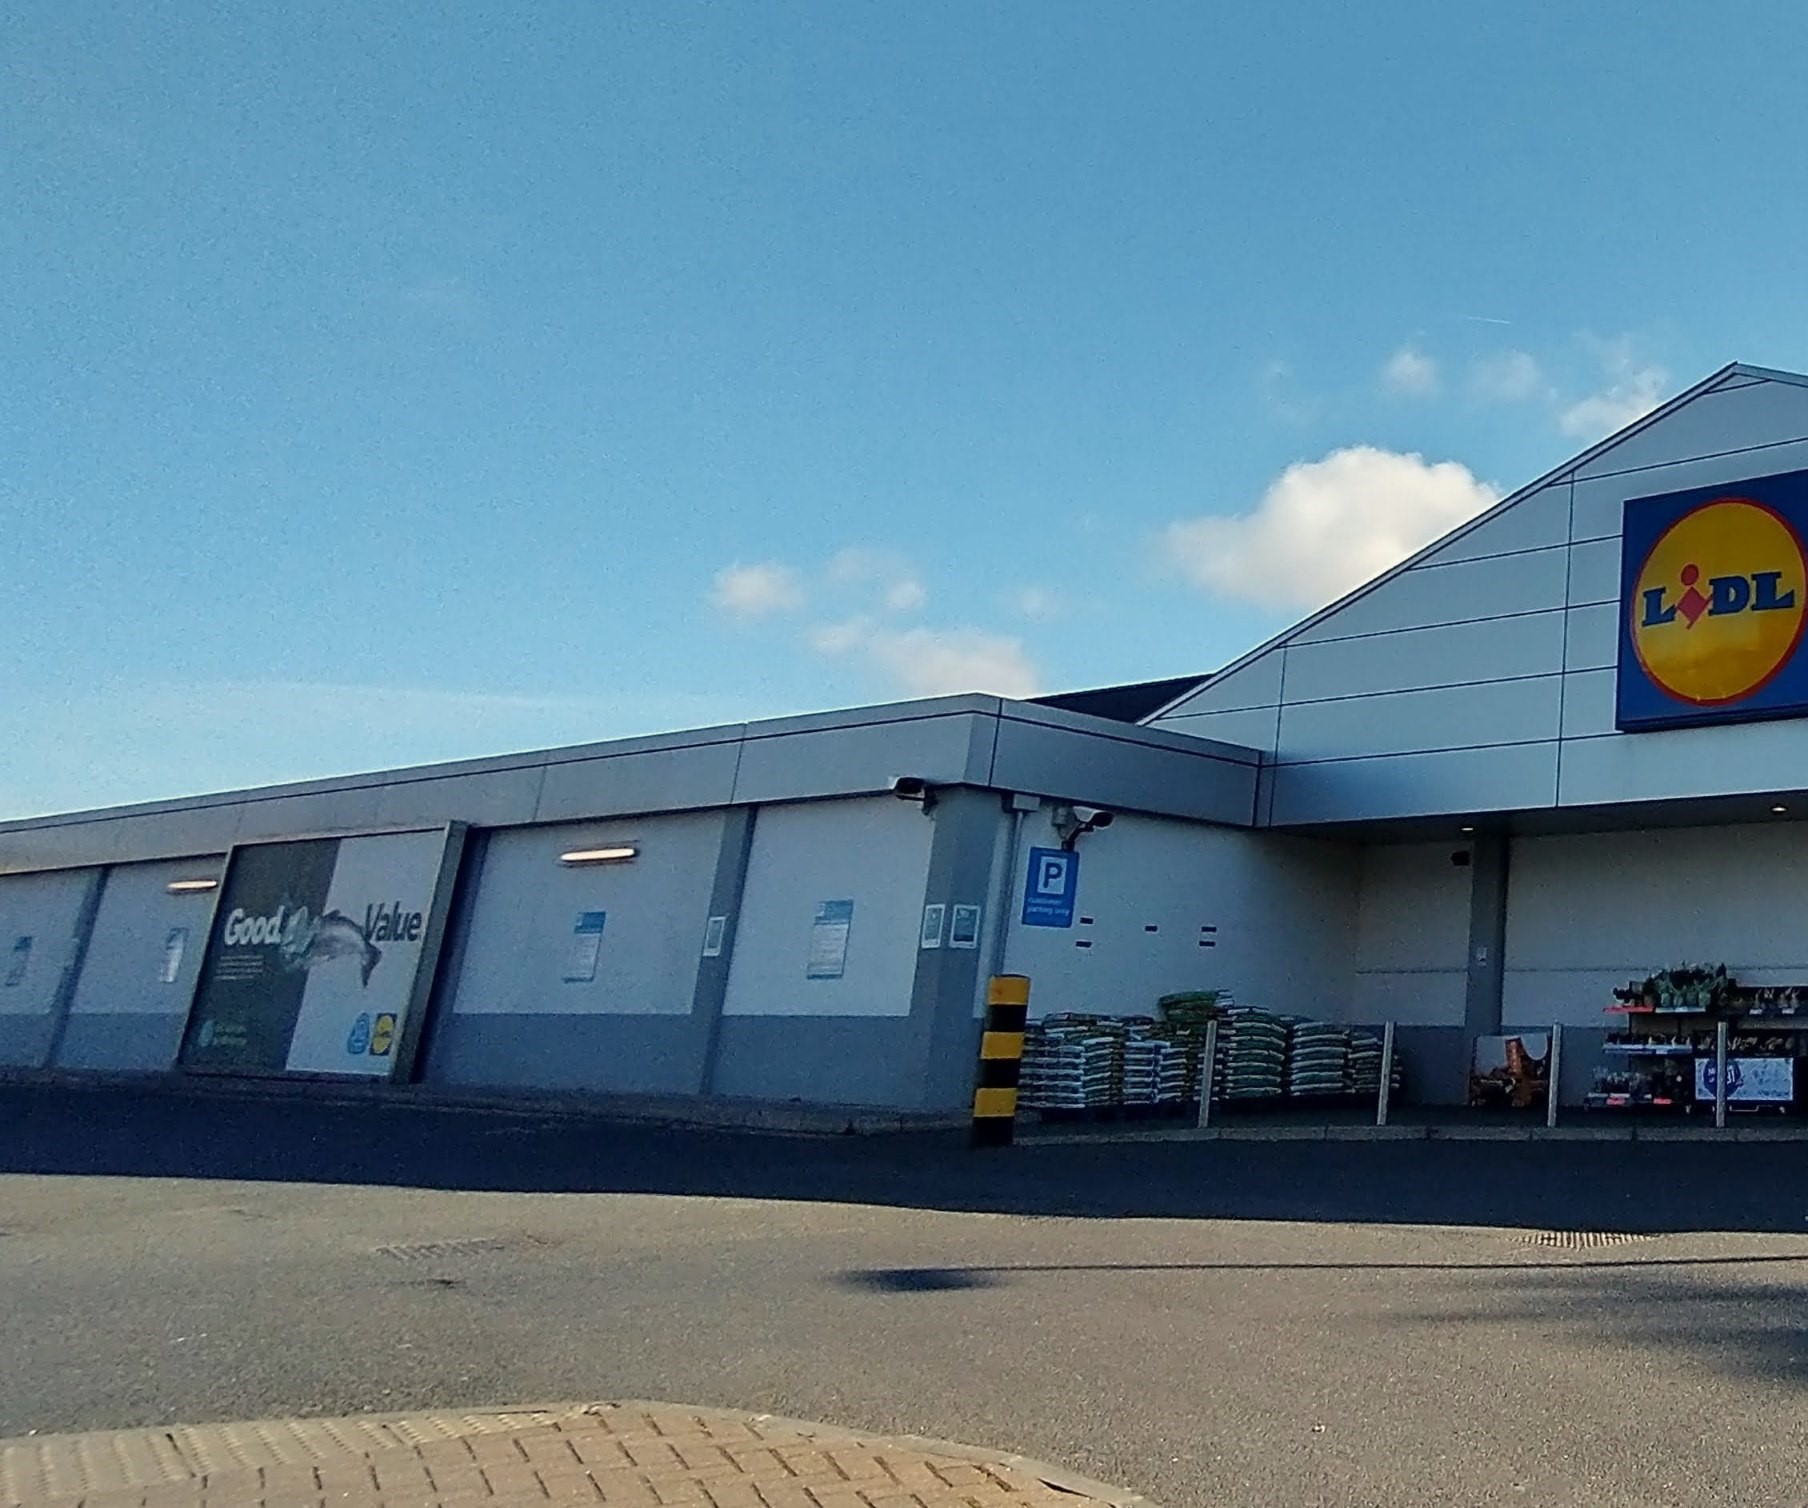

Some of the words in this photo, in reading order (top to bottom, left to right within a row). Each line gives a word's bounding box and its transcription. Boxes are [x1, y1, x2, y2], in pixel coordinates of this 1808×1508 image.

[1043, 862, 1062, 889] P
[224, 905, 285, 946] Good
[365, 901, 422, 942] Value
